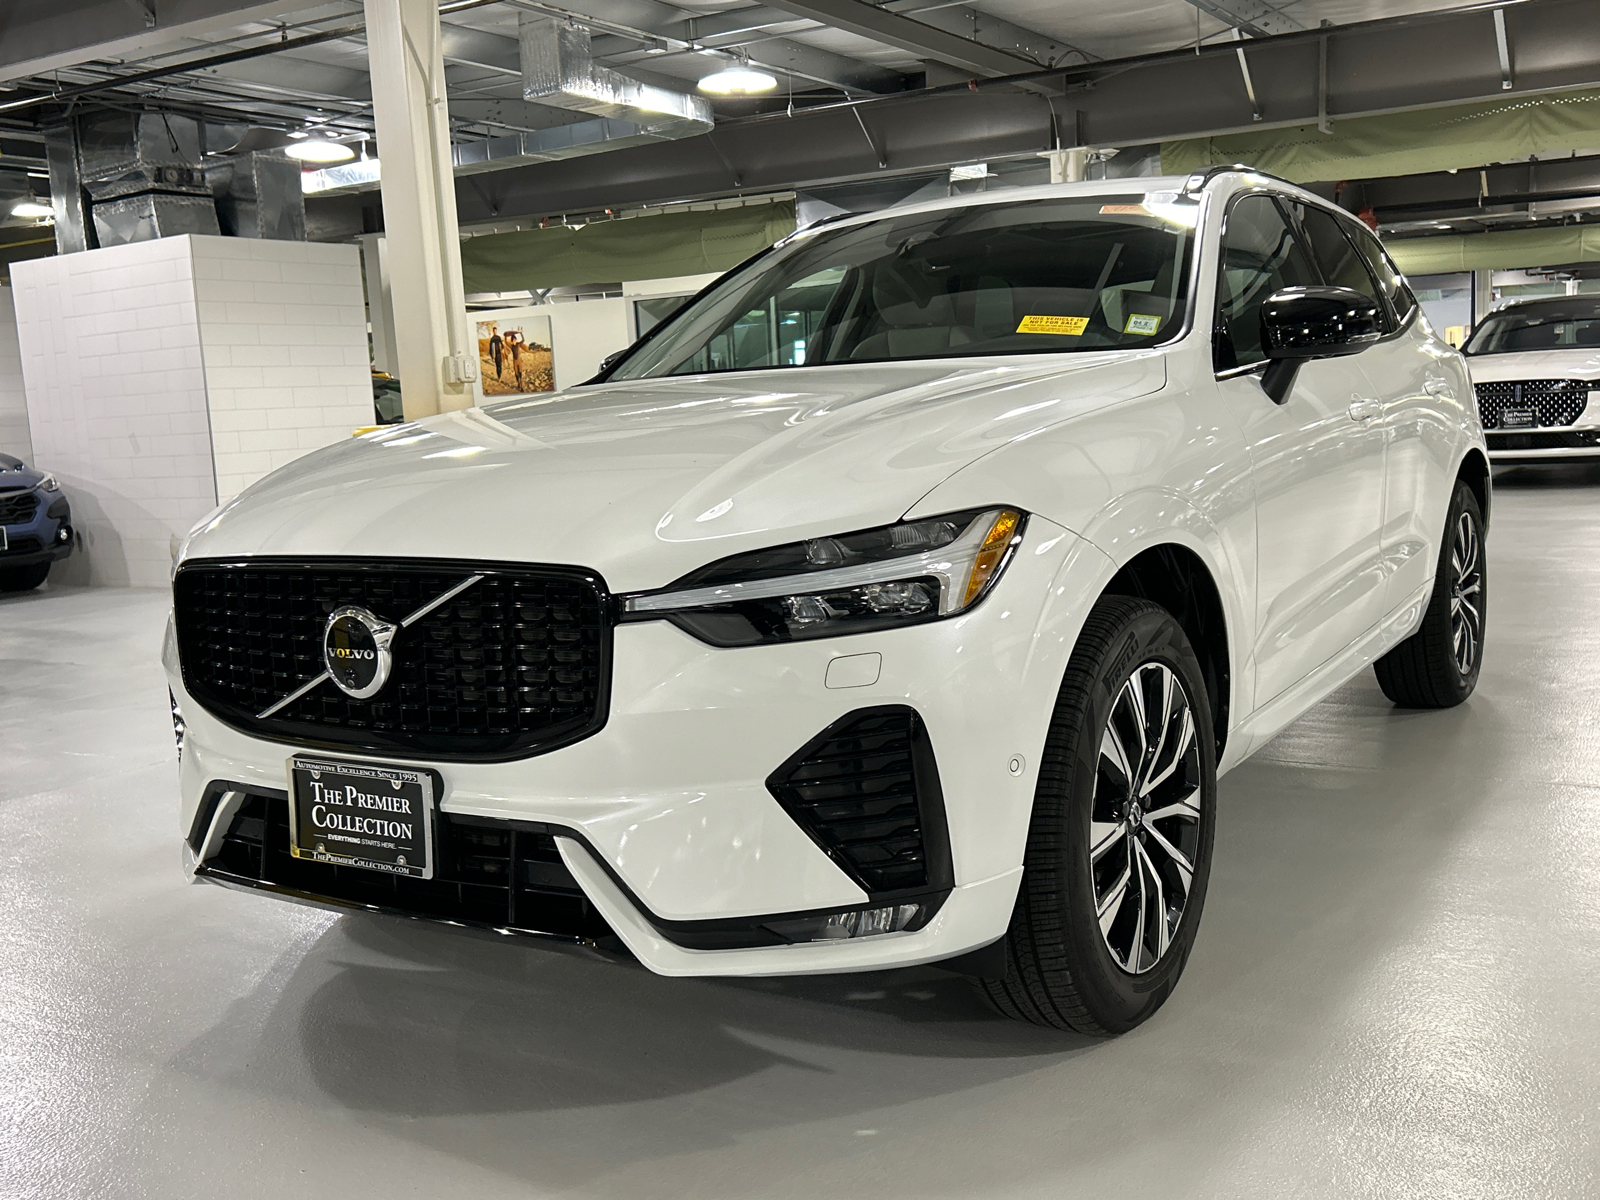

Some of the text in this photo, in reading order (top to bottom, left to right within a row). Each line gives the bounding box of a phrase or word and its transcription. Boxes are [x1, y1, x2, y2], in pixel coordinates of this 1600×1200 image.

[327, 647, 375, 660] VOLVO
[1102, 631, 1139, 698] PIRELLI
[398, 772, 417, 782] 1995
[310, 781, 412, 815] THE PREMIER
[311, 804, 413, 840] COLLECTION
[327, 833, 361, 844] EVERYTHING
[361, 837, 381, 847] STARTS
